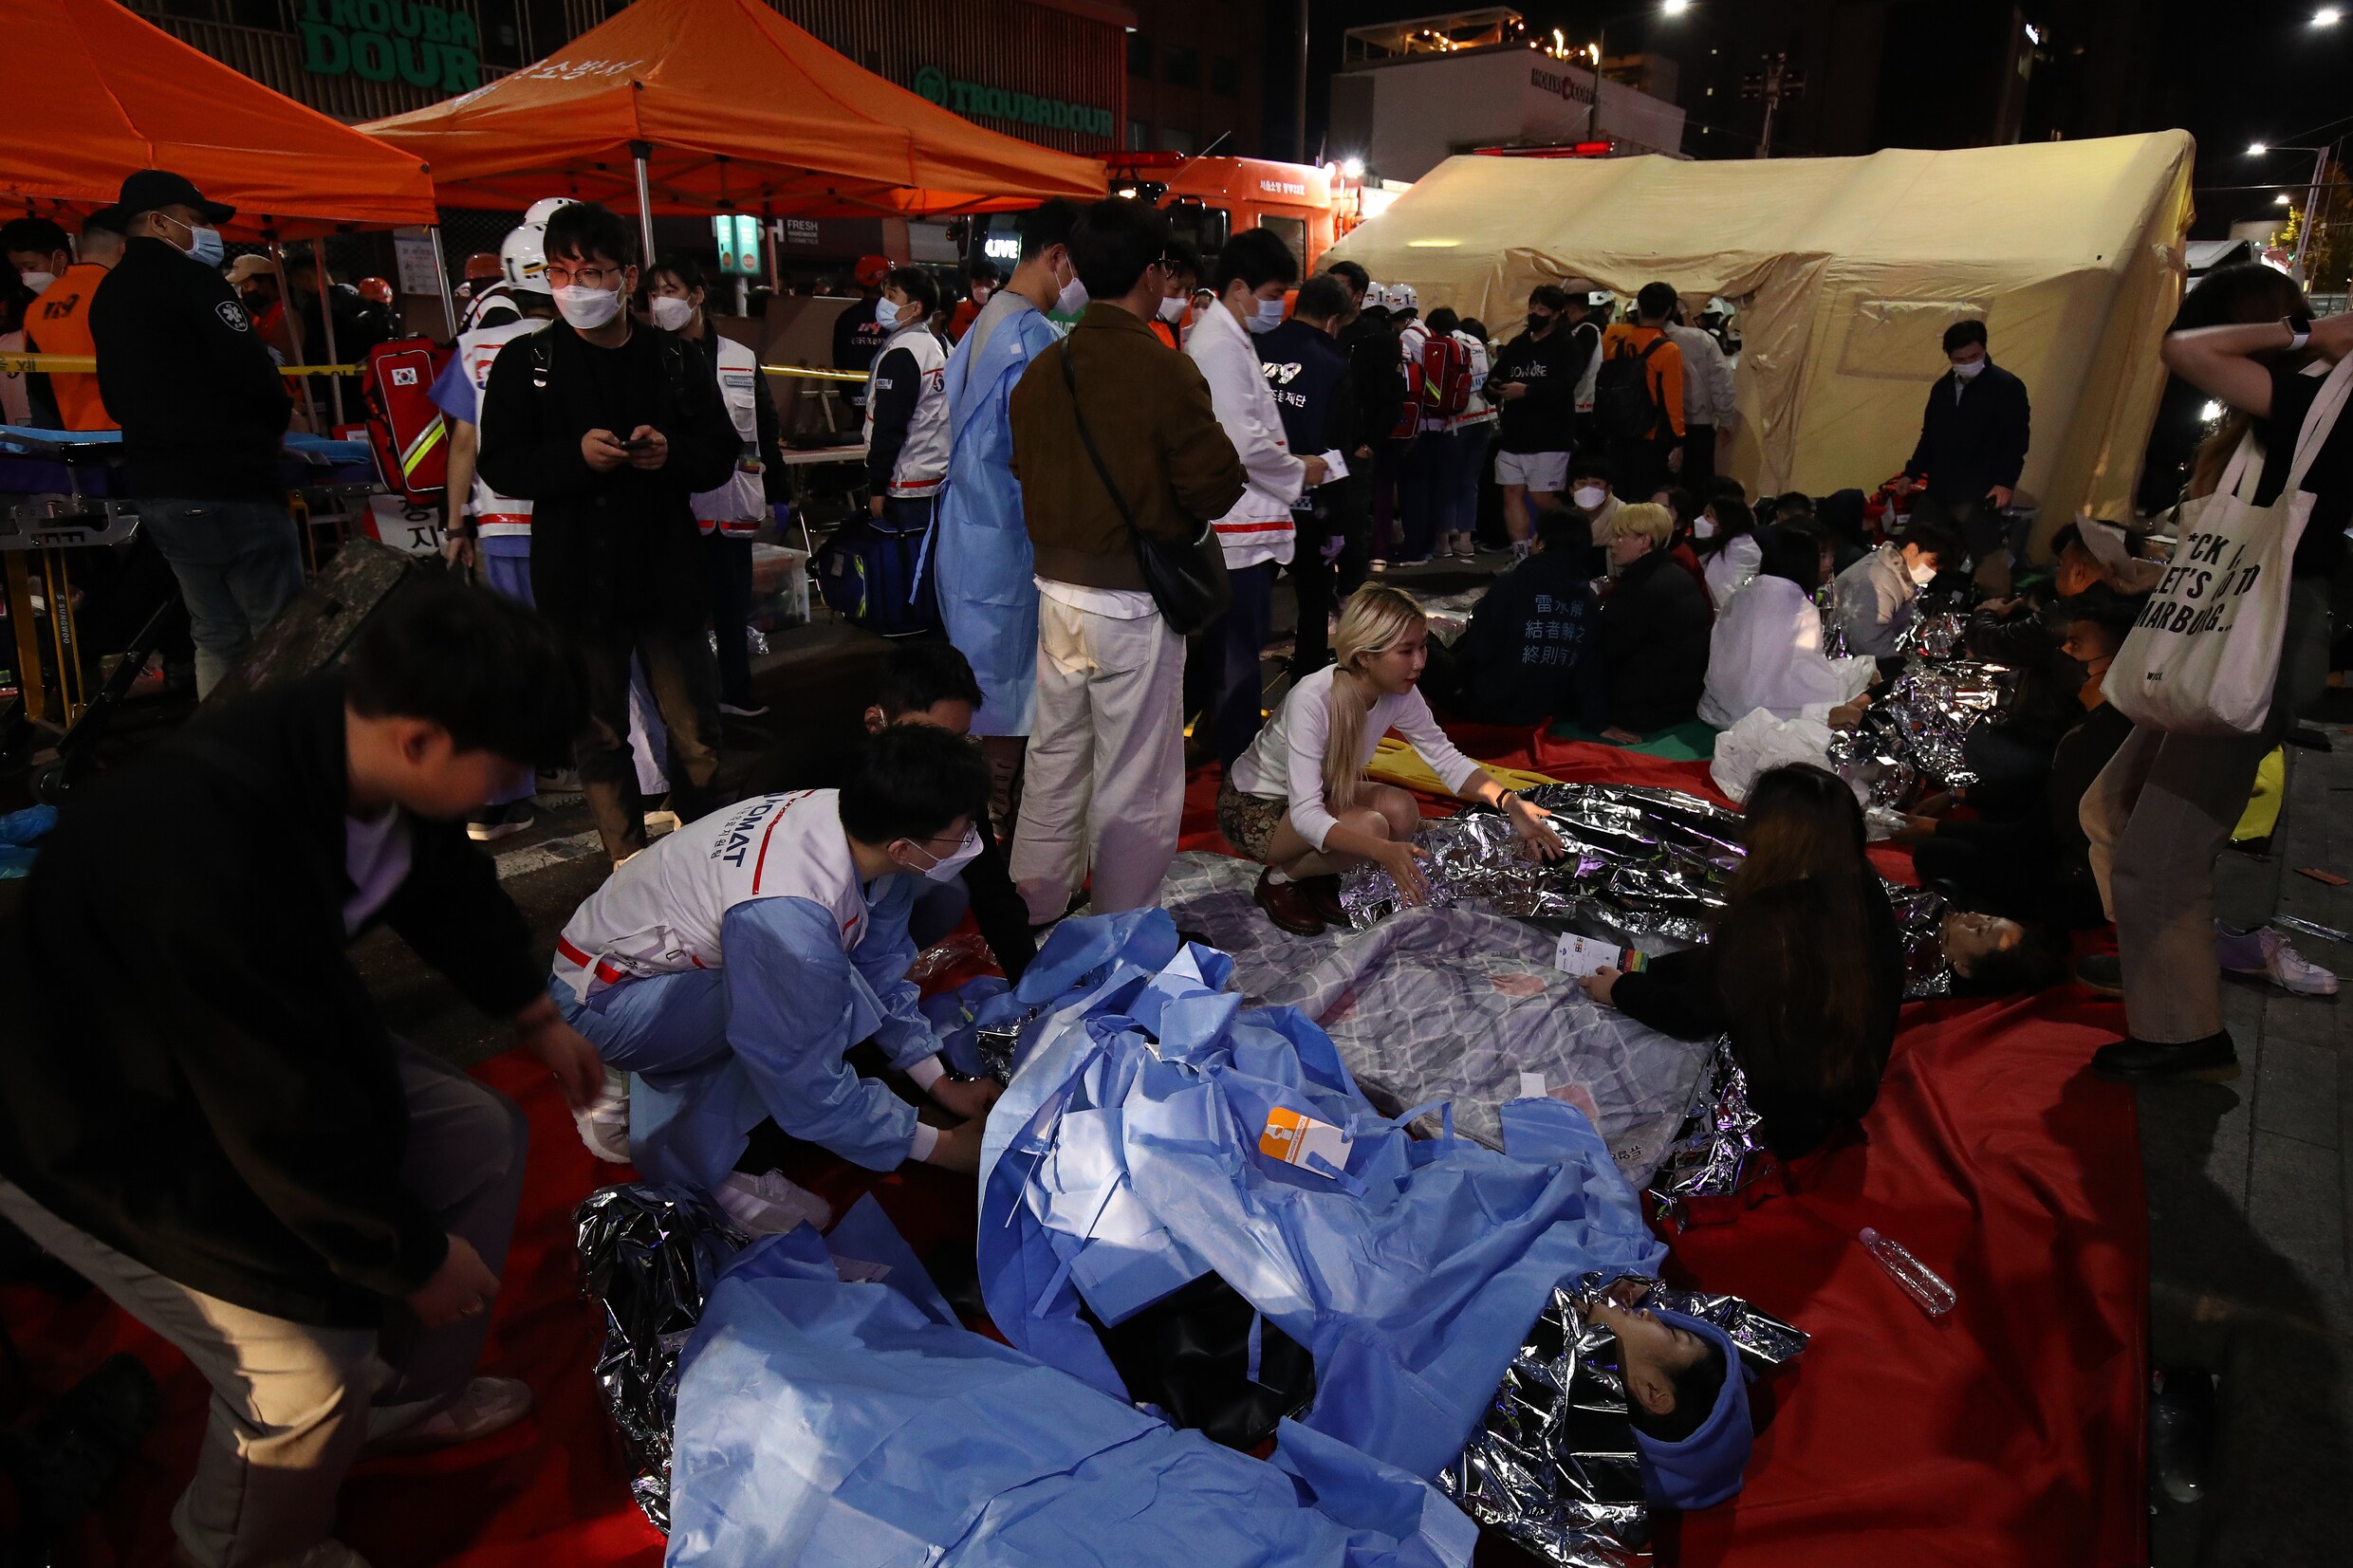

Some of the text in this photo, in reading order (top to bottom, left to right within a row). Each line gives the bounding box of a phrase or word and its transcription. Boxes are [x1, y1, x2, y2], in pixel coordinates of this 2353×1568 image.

[298, 20, 480, 92] DOUR
[950, 79, 1115, 138] TROUBADOUR
[787, 219, 818, 231] FRESH
[2154, 566, 2213, 599] ET'S
[58, 602, 70, 644] SUNGWOO
